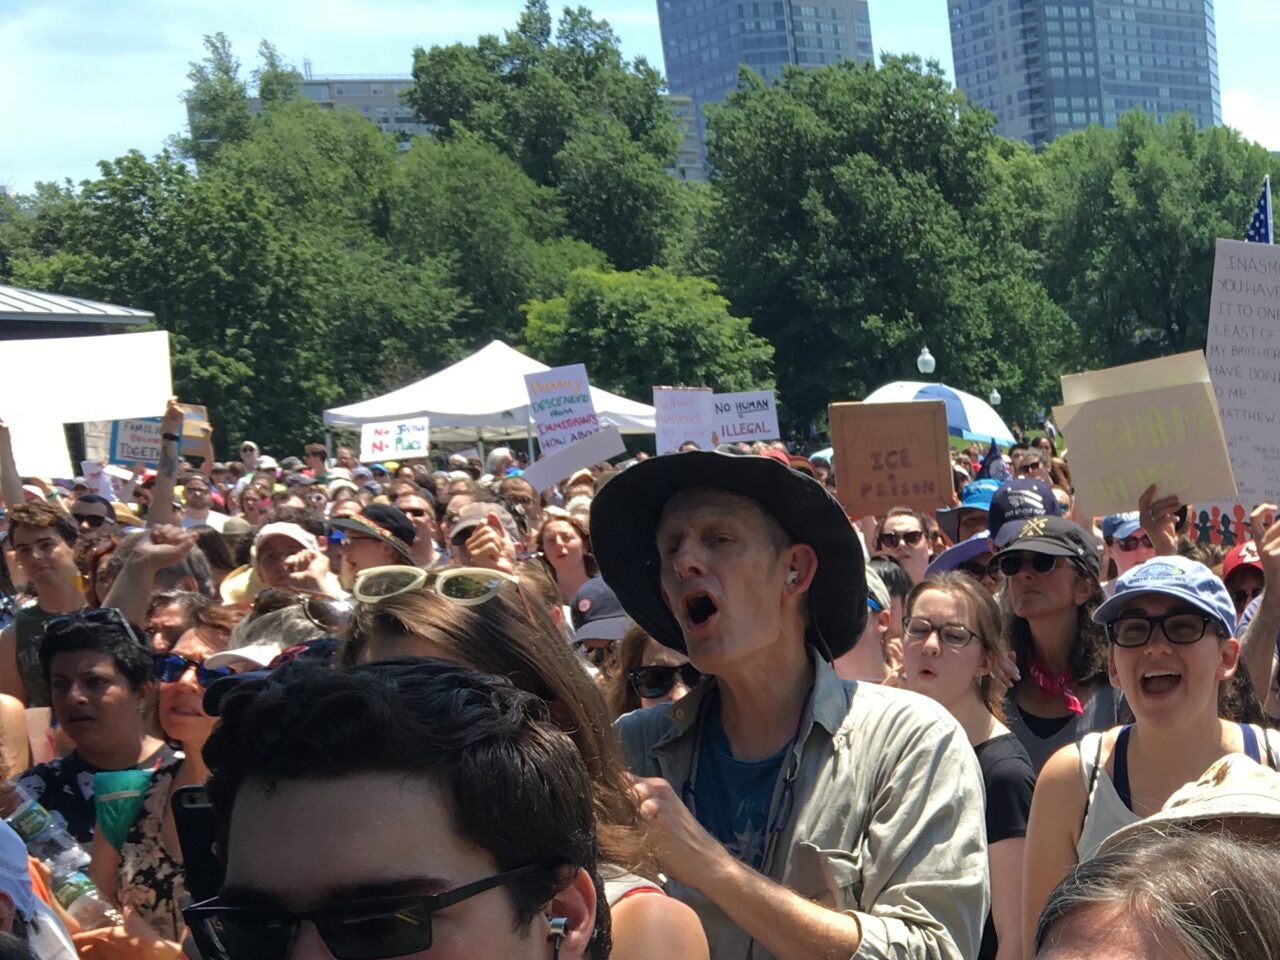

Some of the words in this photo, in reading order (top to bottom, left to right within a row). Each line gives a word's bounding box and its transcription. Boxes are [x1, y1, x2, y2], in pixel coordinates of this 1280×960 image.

[1219, 278, 1242, 294] YOU
[1218, 302, 1234, 316] IT
[1236, 304, 1253, 318] TO
[1215, 323, 1258, 340] LEAST
[1210, 344, 1227, 357] MY
[1210, 364, 1243, 378] HAVE
[714, 403, 731, 414] NO
[735, 399, 769, 412] HUMAN
[721, 422, 771, 437] ILLEGAL
[541, 436, 566, 450] HOW
[870, 448, 914, 471] ICE
[861, 481, 935, 499] PRISON
